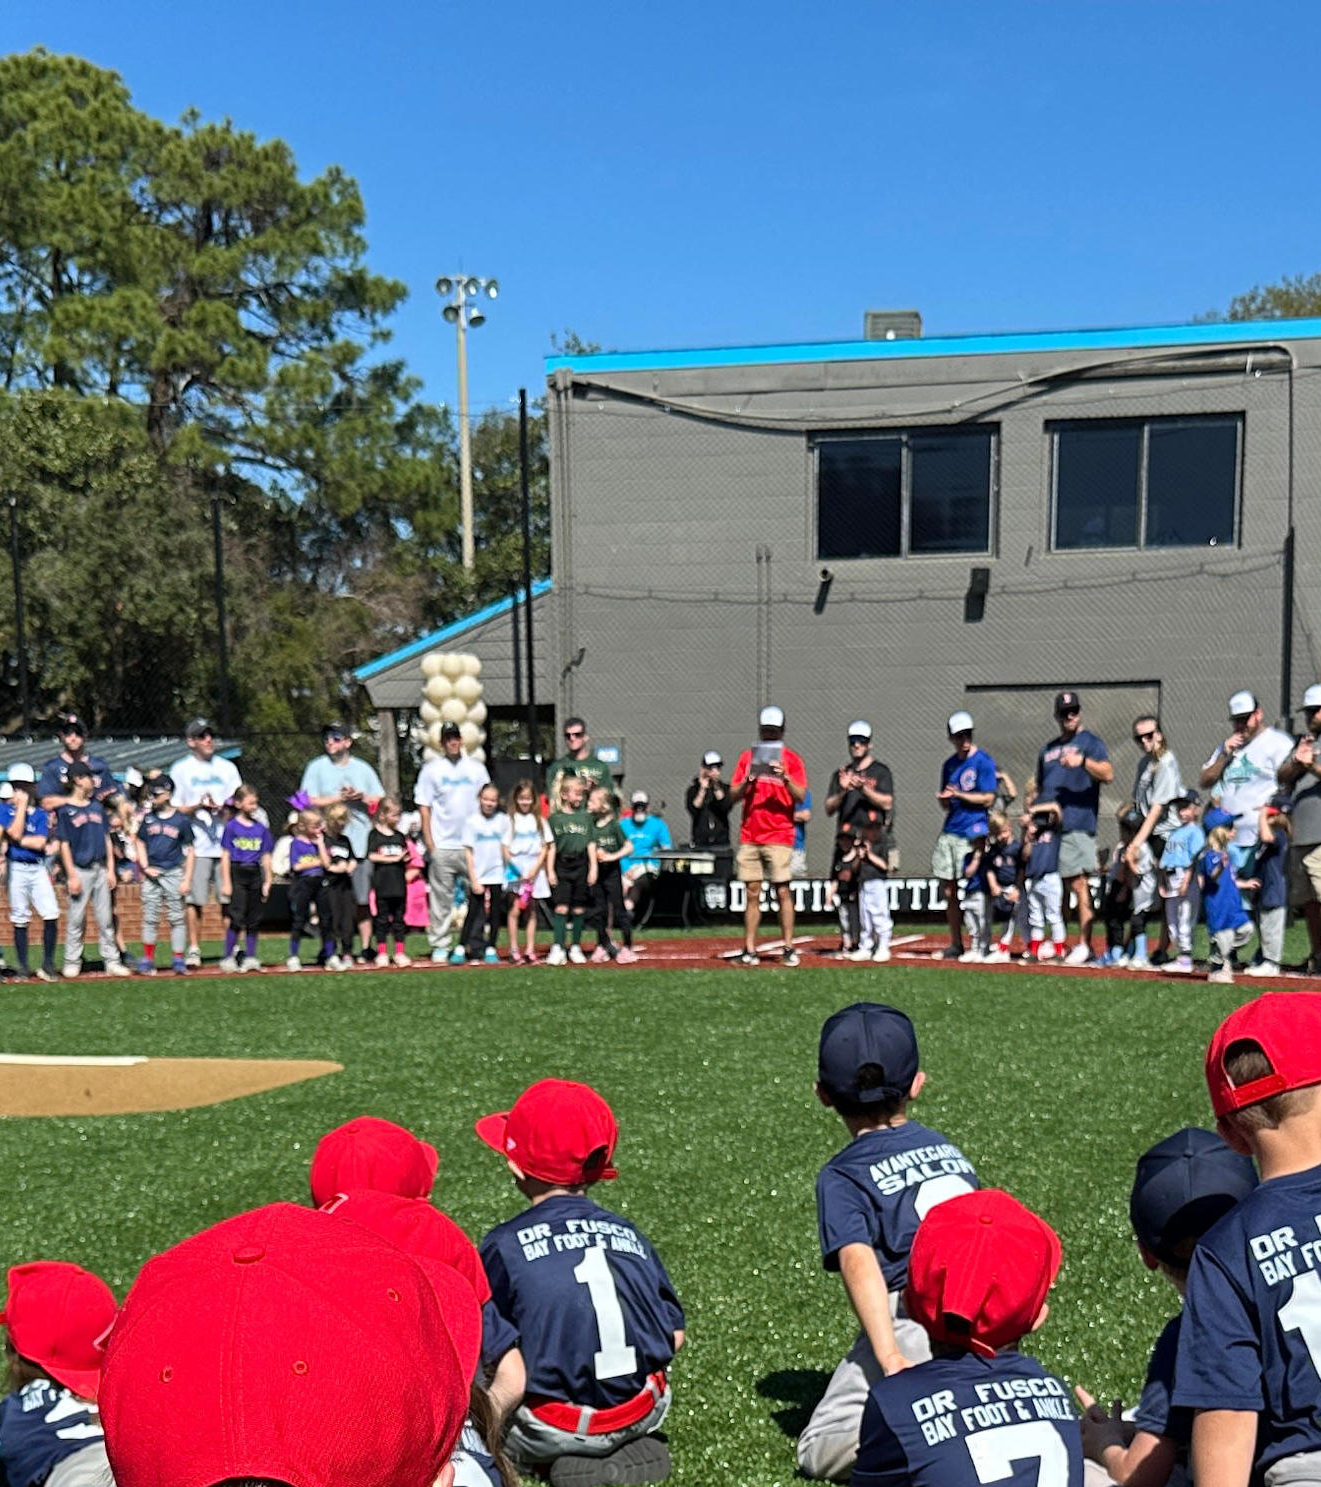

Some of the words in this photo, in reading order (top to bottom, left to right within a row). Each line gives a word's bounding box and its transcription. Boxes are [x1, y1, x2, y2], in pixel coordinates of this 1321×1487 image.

[517, 1222, 552, 1246] DR
[522, 1238, 550, 1262] BAY
[553, 1233, 590, 1252] FOOT
[1249, 1226, 1299, 1261] DR
[1259, 1250, 1297, 1286] BAY
[574, 1245, 637, 1380] 1
[911, 1389, 958, 1423] DR
[920, 1413, 958, 1447] BAY
[960, 1399, 1012, 1432] FOOT
[1013, 1399, 1031, 1421] &
[1032, 1397, 1075, 1421] ANKLE
